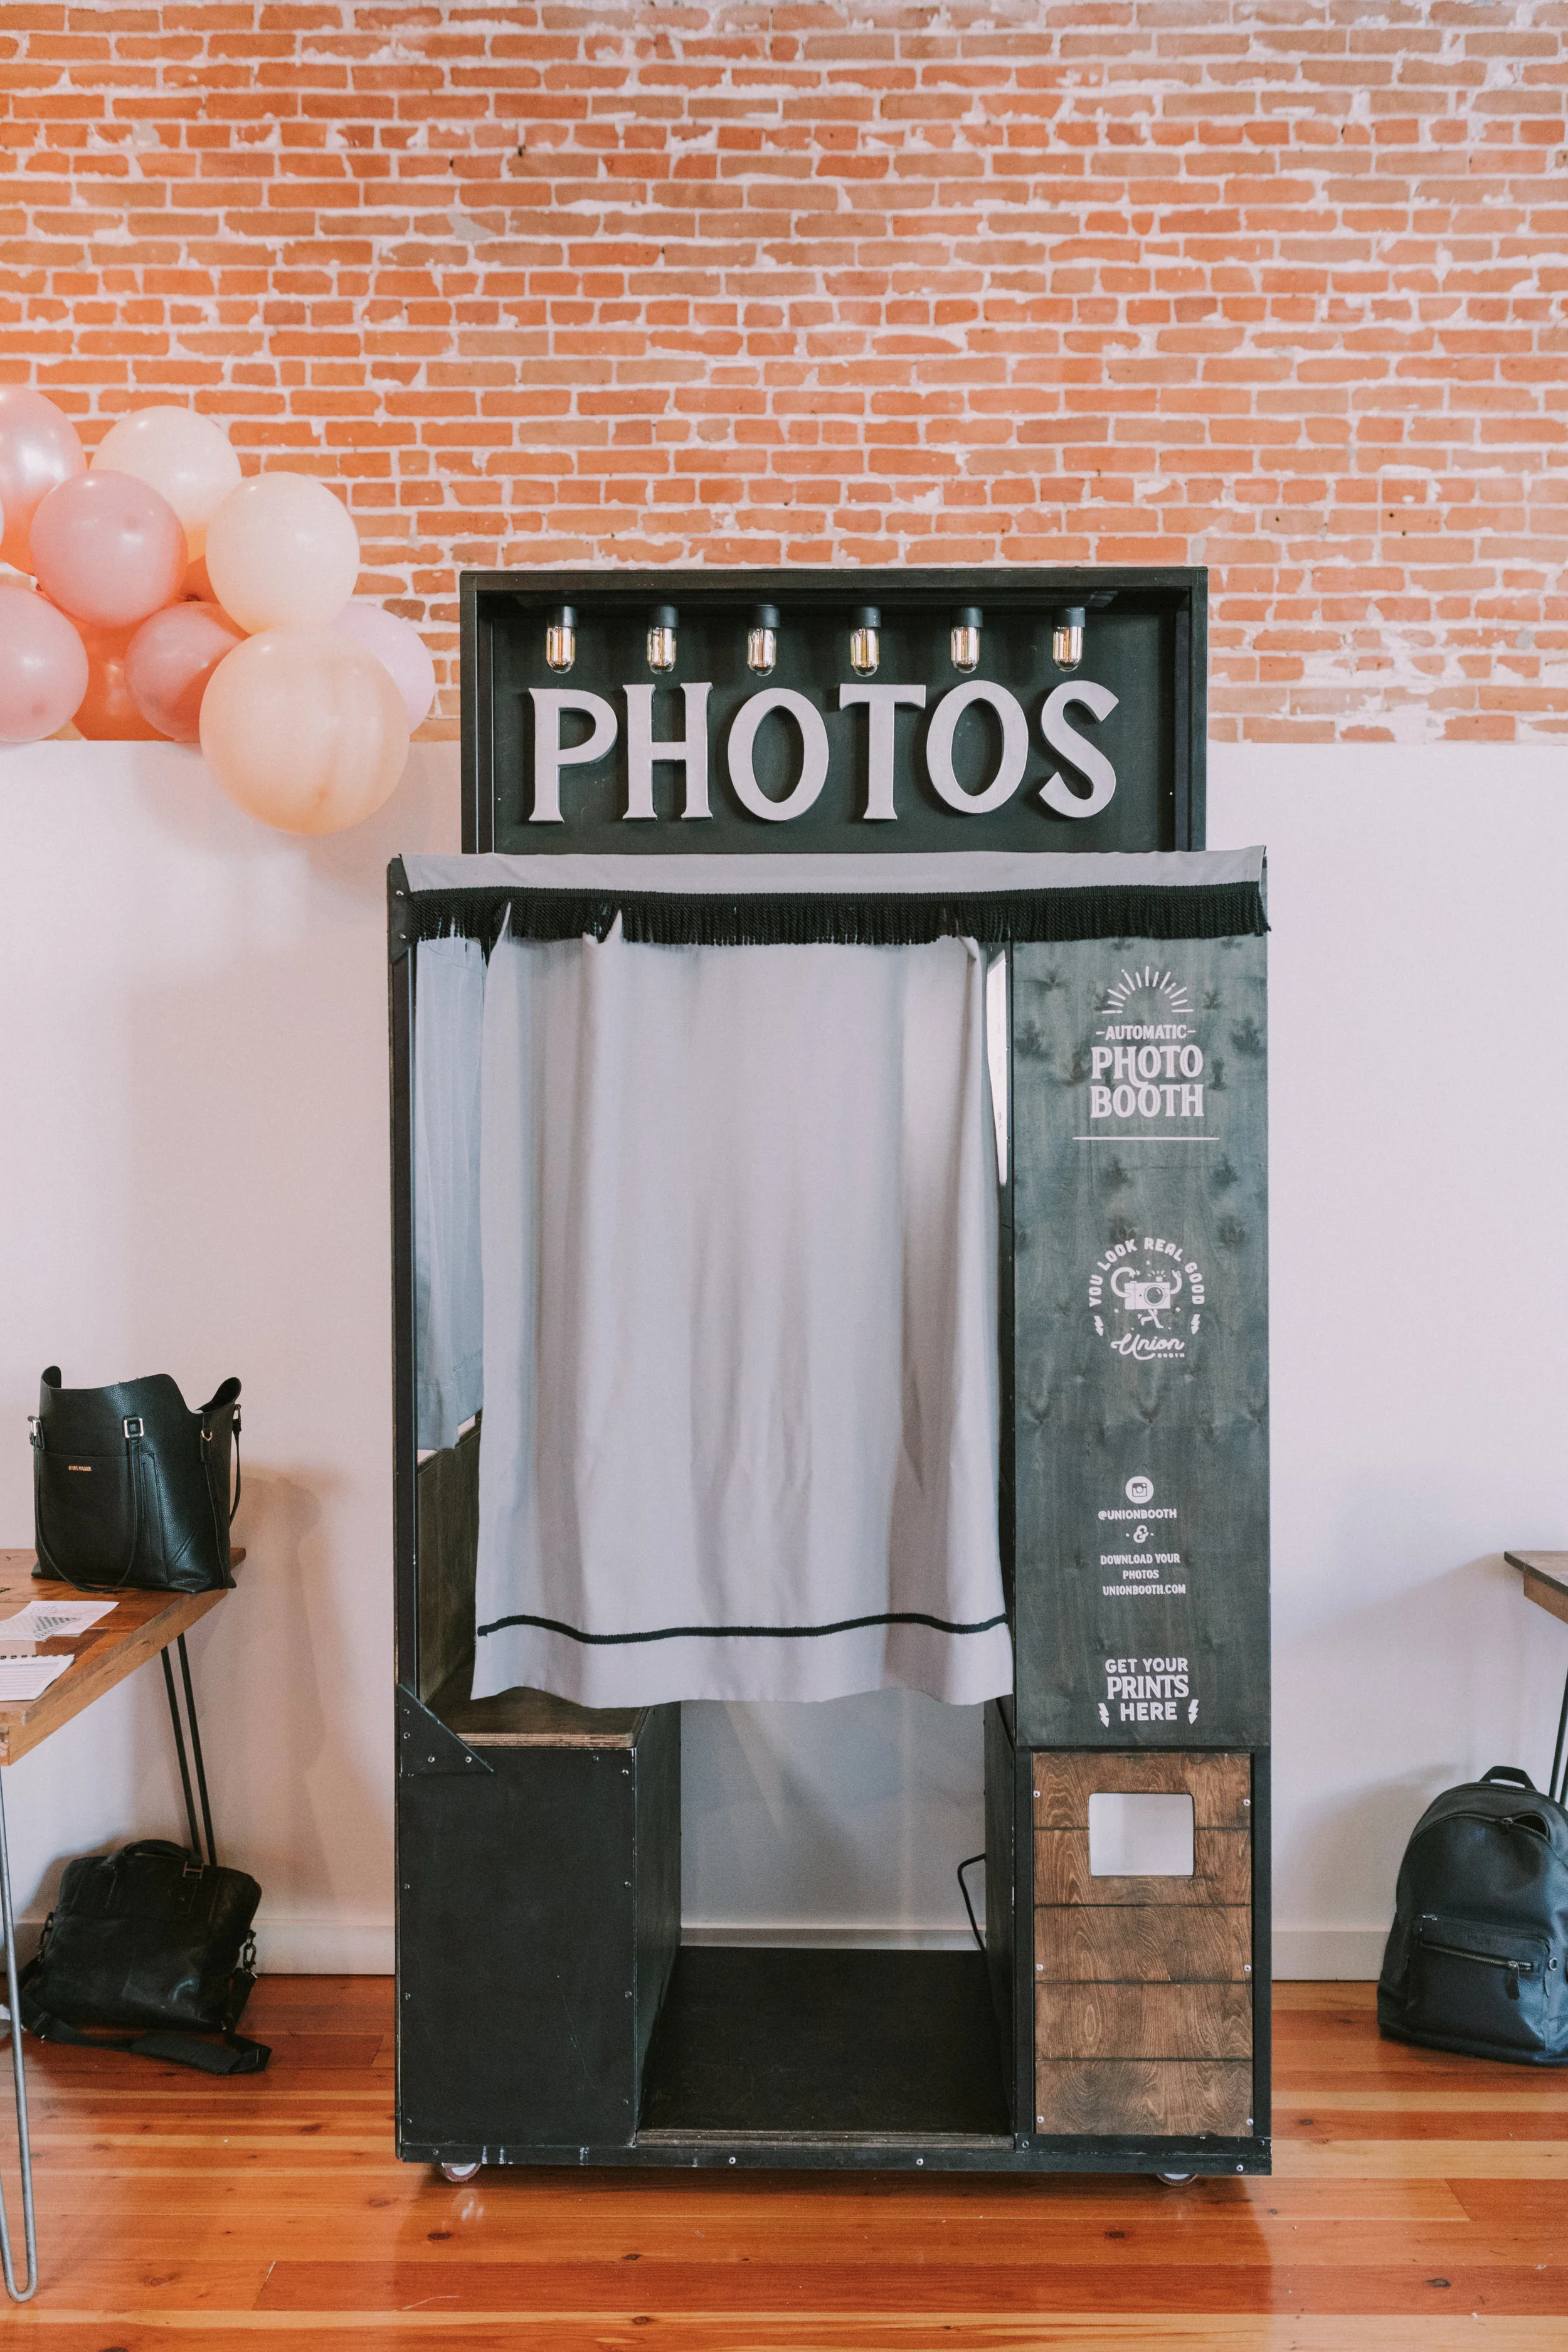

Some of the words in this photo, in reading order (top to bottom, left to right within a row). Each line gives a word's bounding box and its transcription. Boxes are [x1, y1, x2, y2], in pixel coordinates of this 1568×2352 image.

[527, 679, 1120, 822] PHOTOS
[1104, 1024, 1187, 1041] AUTOMATIC
[1091, 1044, 1204, 1087] PHOTO
[1090, 1084, 1205, 1118] BOOTH
[1088, 1274, 1103, 1307] YOU
[1097, 1238, 1138, 1271] LOOK
[1143, 1237, 1184, 1262] REAL
[1184, 1262, 1205, 1305] GOOD
[1110, 1333, 1185, 1360] Union
[1098, 1508, 1177, 1520] @UNIONBOOTH
[1133, 1525, 1149, 1543] &
[1100, 1554, 1153, 1565] DOWNLOAD
[1155, 1553, 1180, 1564] YOUR
[1123, 1569, 1160, 1579] PHOTOS
[1103, 1584, 1186, 1596] UNIONBOOTH.COM
[1105, 1658, 1138, 1673] GET
[1142, 1657, 1189, 1672] YOUR
[1107, 1675, 1189, 1700] PRINTS
[1120, 1702, 1177, 1721] HERE
